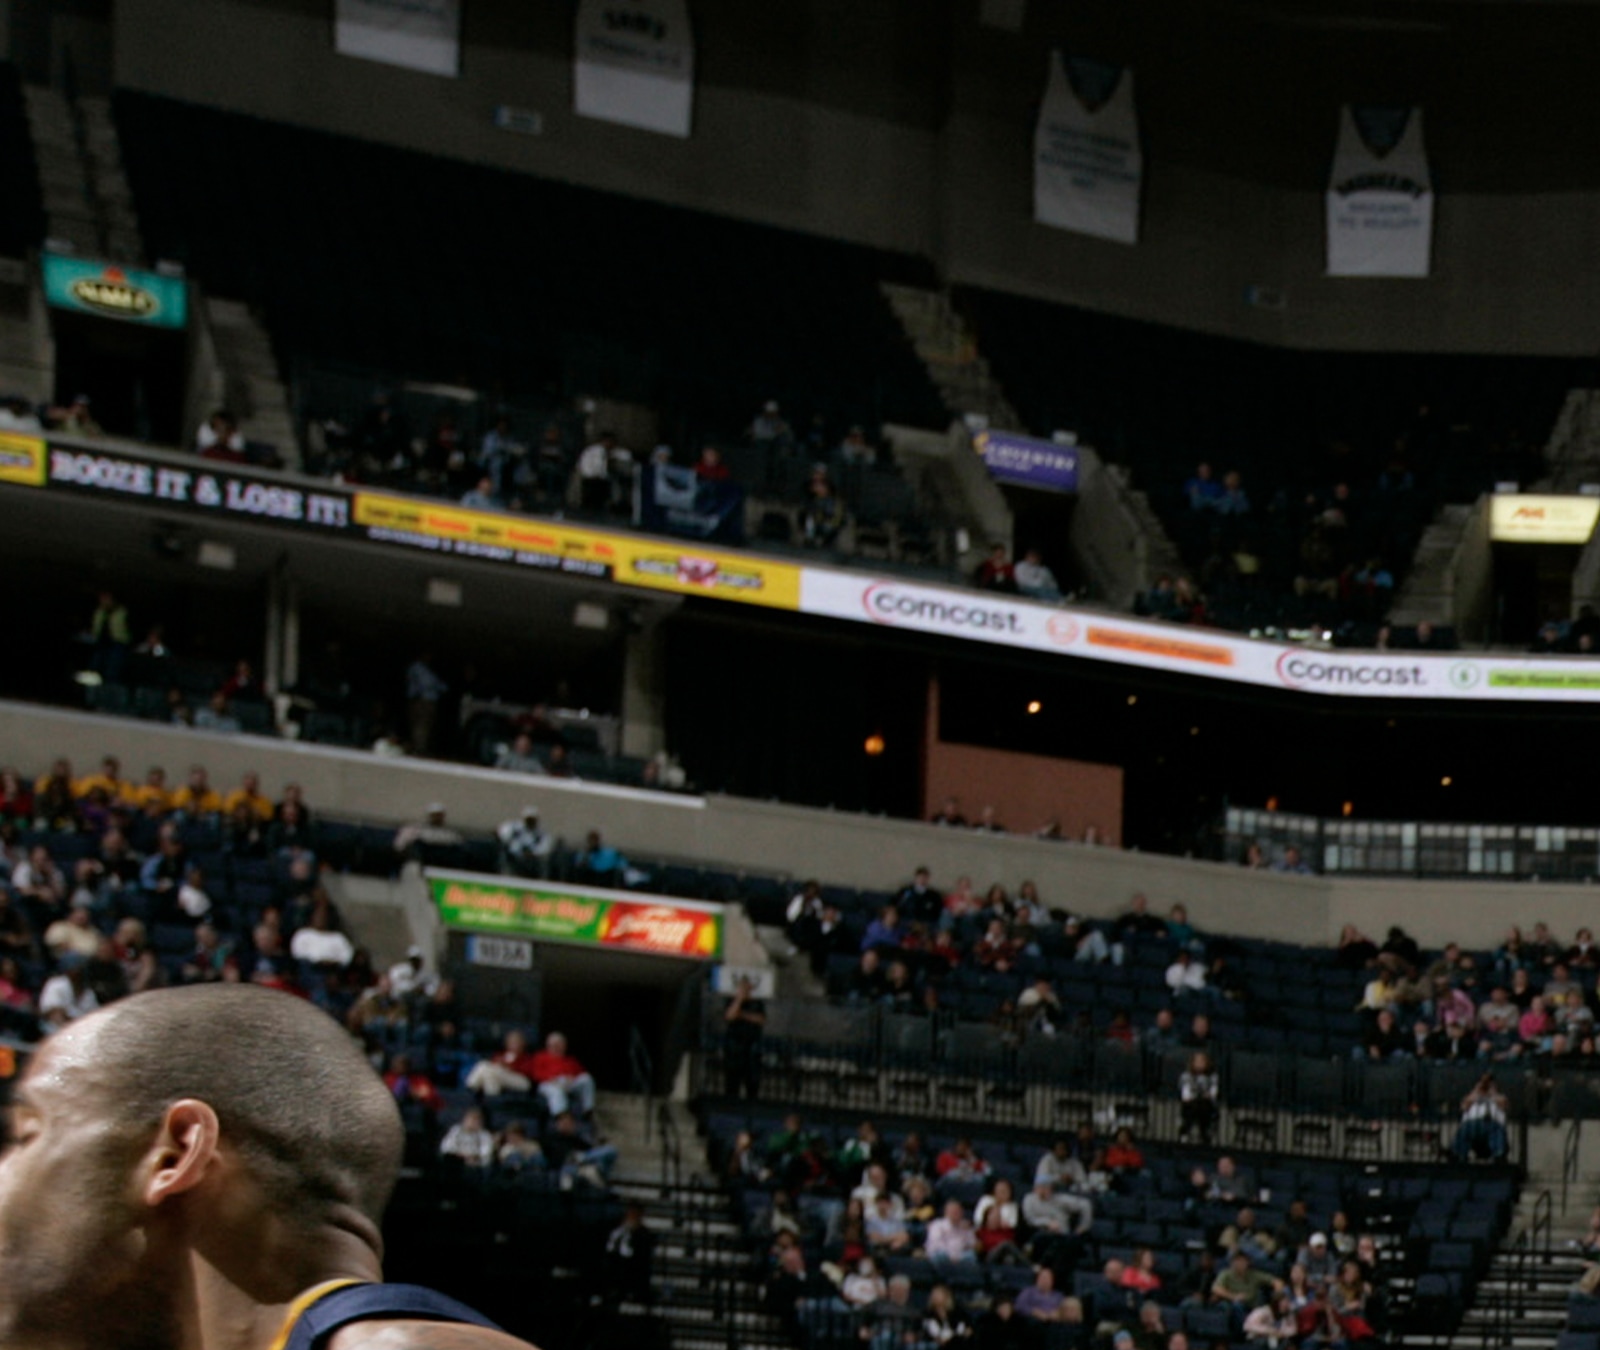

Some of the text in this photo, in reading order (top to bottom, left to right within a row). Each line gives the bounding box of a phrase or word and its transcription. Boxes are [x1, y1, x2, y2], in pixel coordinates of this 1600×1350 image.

[50, 450, 152, 494] BOOZE
[156, 467, 192, 501] IT
[195, 476, 222, 507] &
[225, 480, 304, 520] LOSE
[306, 494, 349, 528] IT!
